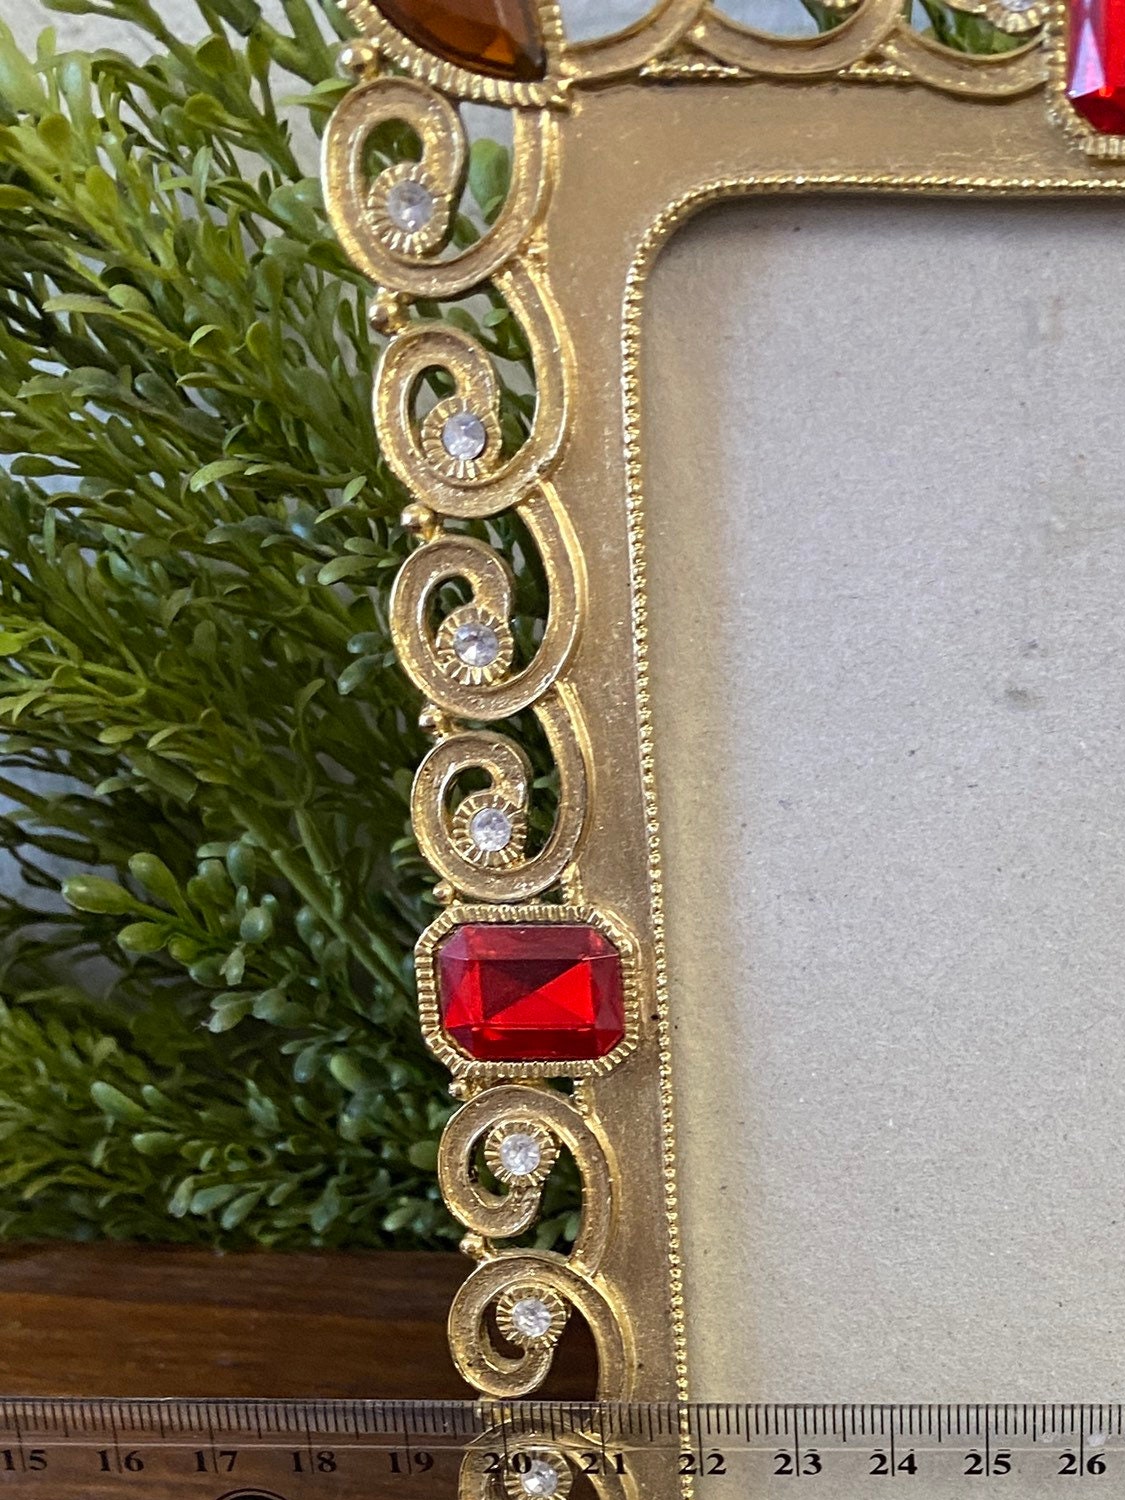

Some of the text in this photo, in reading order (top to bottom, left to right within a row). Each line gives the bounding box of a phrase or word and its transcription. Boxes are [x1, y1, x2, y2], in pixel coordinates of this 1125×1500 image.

[2, 1449, 48, 1472] 15
[98, 1450, 145, 1473] 16
[195, 1450, 238, 1473] 17
[292, 1451, 337, 1473] 18
[390, 1452, 434, 1474] 19
[483, 1452, 532, 1474] 20
[581, 1453, 627, 1474] 21
[678, 1453, 727, 1475] 22
[774, 1453, 822, 1475] 23
[869, 1453, 918, 1475] 24
[964, 1453, 1012, 1475] 25
[1057, 1453, 1107, 1475] 26
